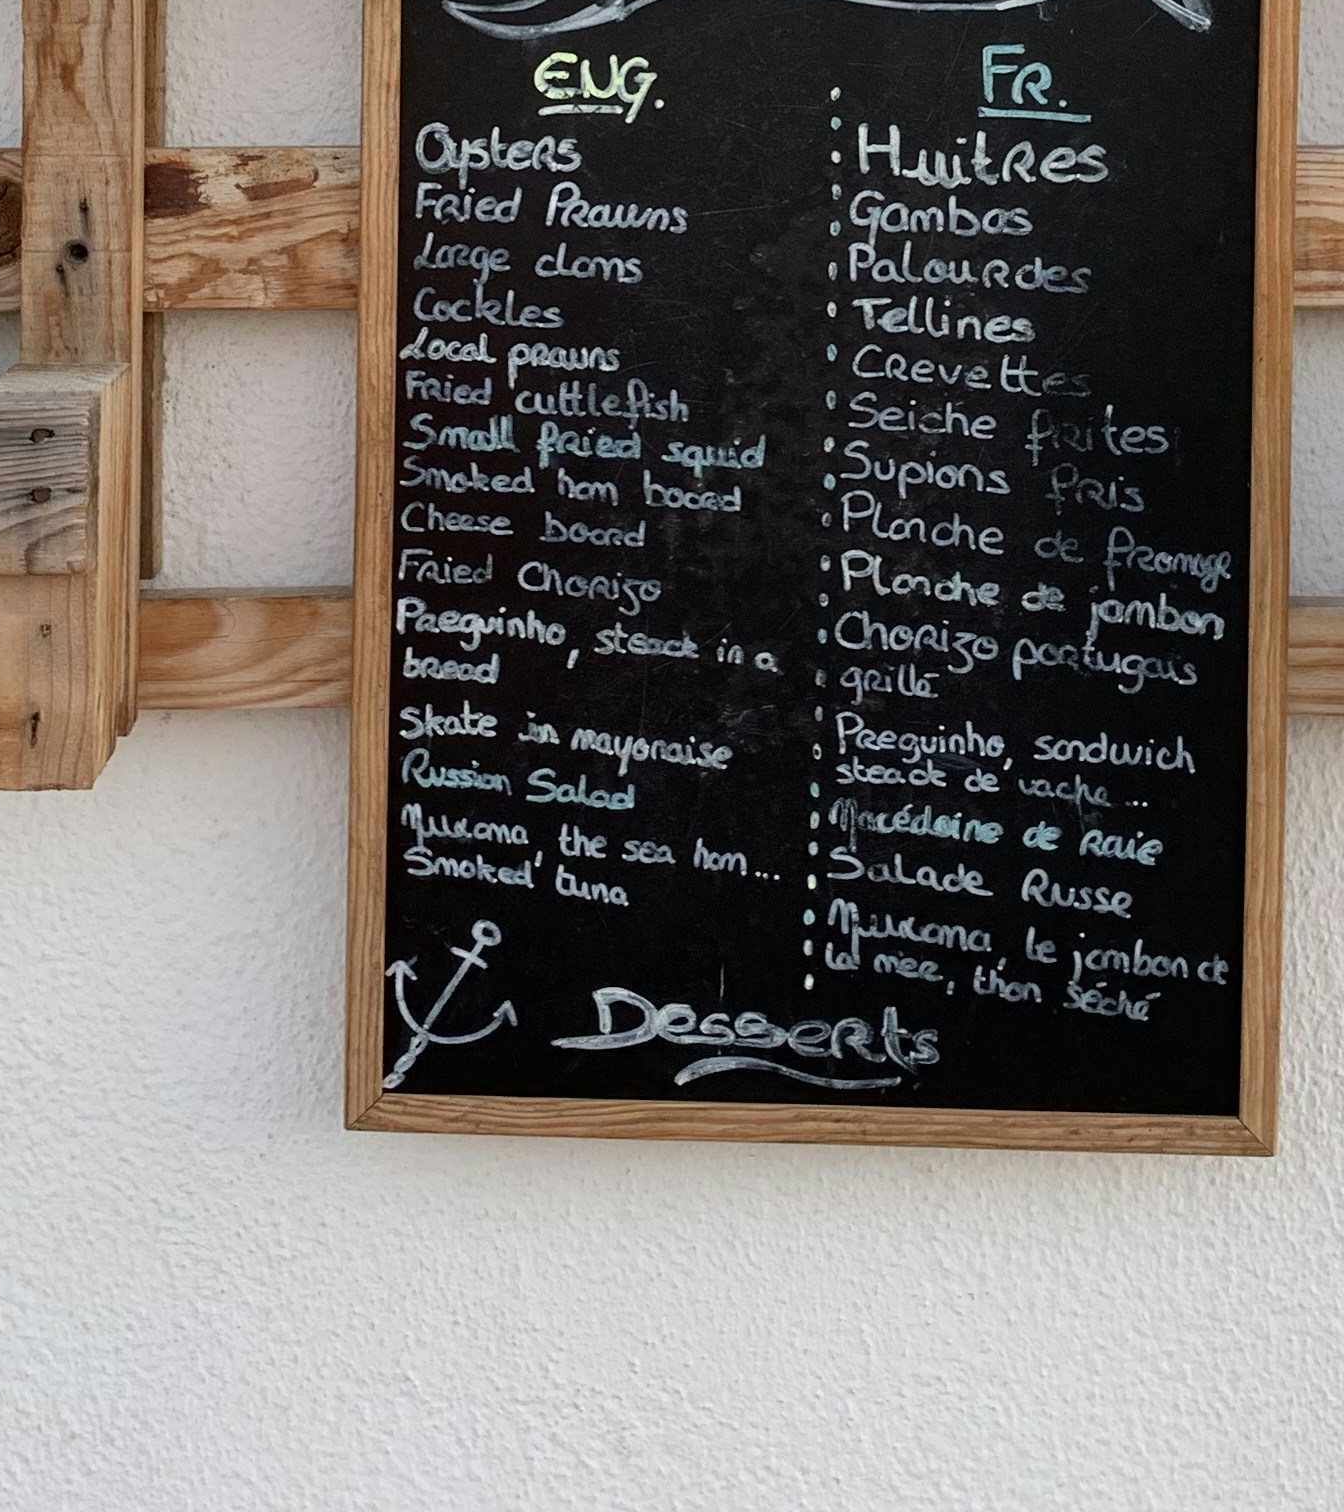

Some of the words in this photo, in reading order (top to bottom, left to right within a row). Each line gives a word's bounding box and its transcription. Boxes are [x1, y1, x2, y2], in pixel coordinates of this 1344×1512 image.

[849, 190, 1033, 248] Gambas
[534, 242, 644, 283] clams
[413, 278, 565, 328] Cockles
[852, 295, 1036, 343] Tellines
[399, 326, 497, 363] Local
[514, 377, 690, 429] cuttlefish
[848, 391, 997, 439] Seiche
[403, 413, 520, 453] Small
[661, 435, 767, 478] squid
[840, 439, 1012, 500] Supions
[399, 455, 535, 494] Smoked
[557, 467, 619, 507] ham
[400, 500, 514, 536] Cheese
[840, 490, 1005, 555] Planche
[1034, 530, 1086, 564] de
[840, 549, 1001, 606] Planche
[1021, 582, 1066, 612] de
[1084, 585, 1226, 642] jambon
[716, 638, 745, 664] in
[399, 701, 498, 740] Skate
[518, 711, 560, 744] in
[1034, 732, 1196, 774] sandwich
[402, 748, 513, 796] Russian
[526, 767, 636, 809] Salad
[964, 768, 1000, 793] de
[558, 823, 607, 859] the
[622, 838, 676, 864] sea
[1022, 821, 1063, 850] de
[403, 845, 535, 888] Smoked
[556, 864, 629, 906] tuna
[827, 845, 994, 896] Salade
[1021, 868, 1134, 918] Russe
[973, 964, 1043, 1004] thon
[1067, 931, 1189, 987] jambon
[1196, 953, 1229, 985] de
[551, 986, 941, 1076] Desserts
